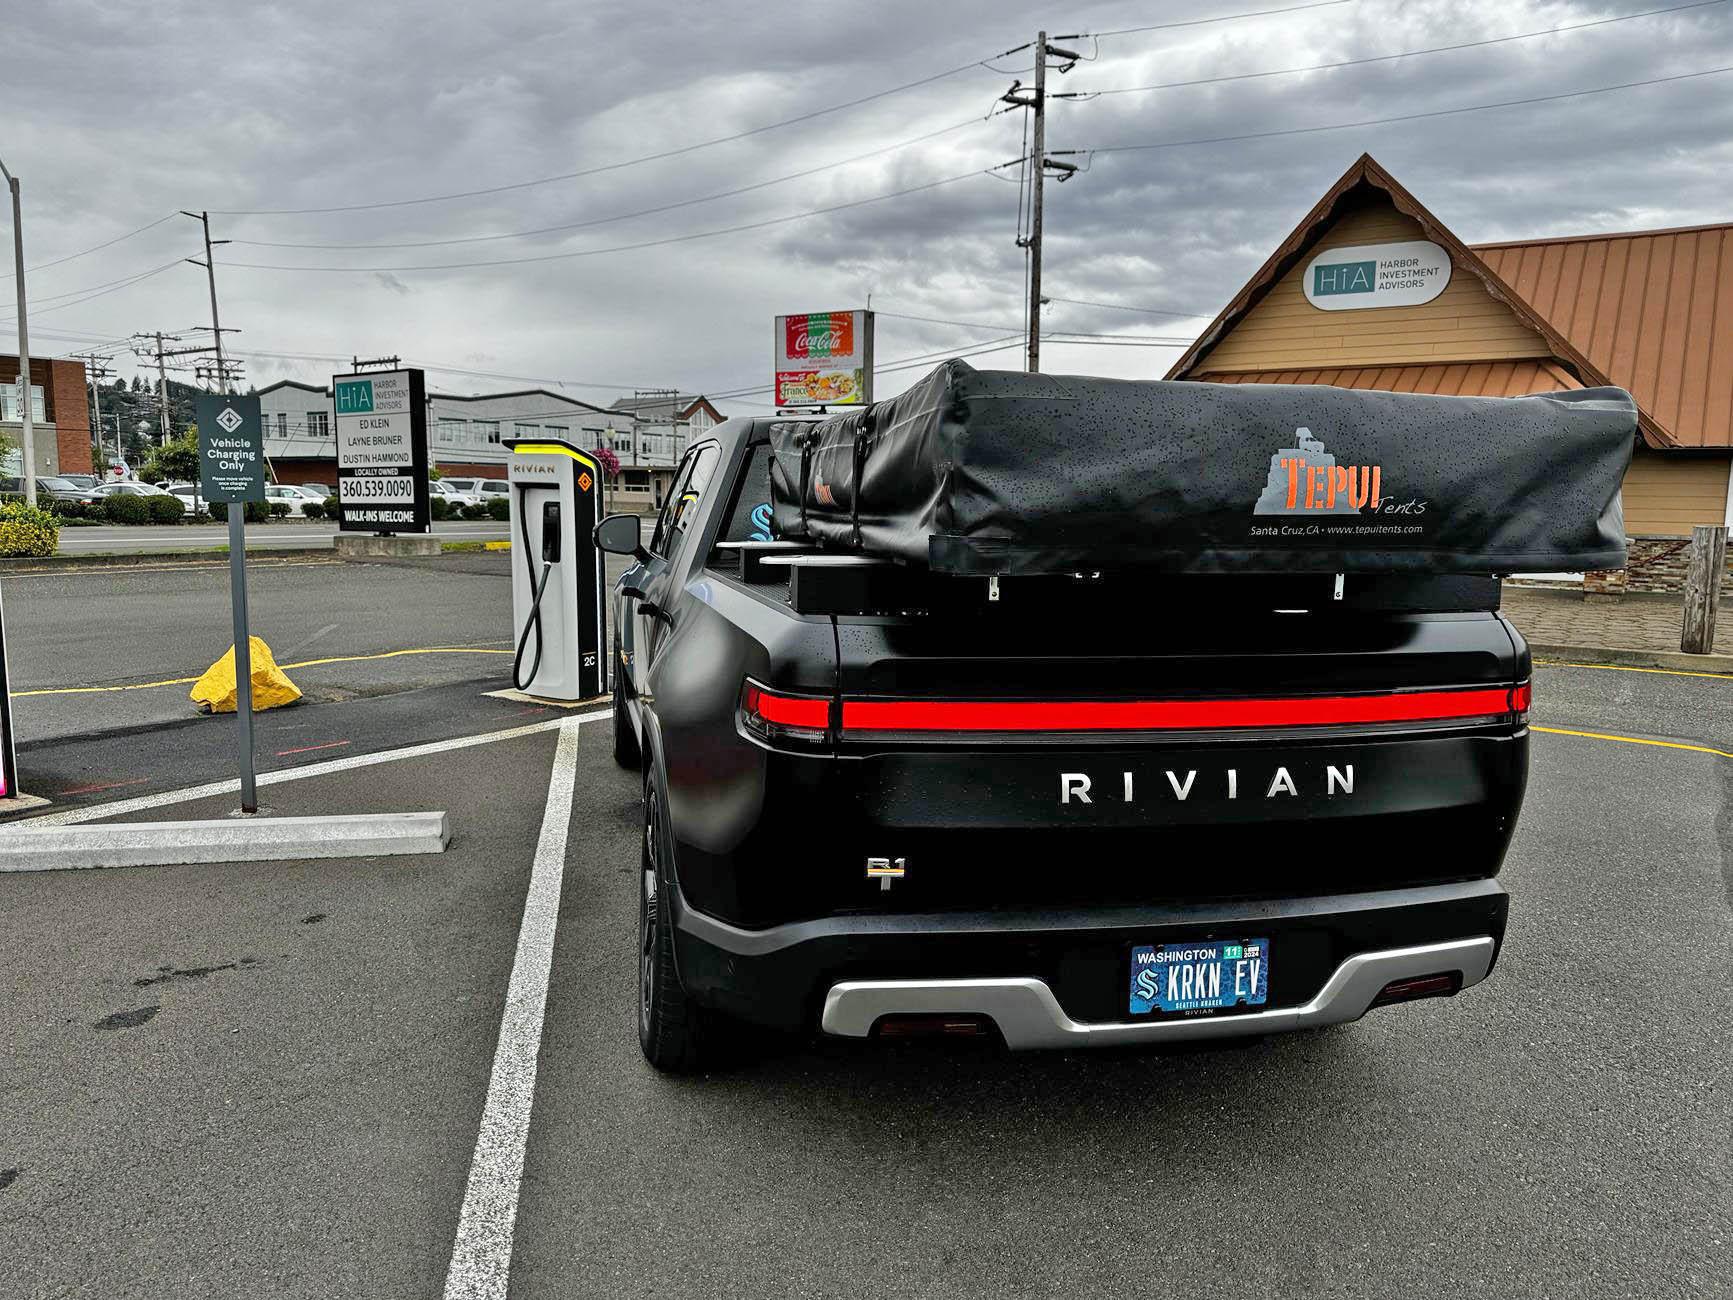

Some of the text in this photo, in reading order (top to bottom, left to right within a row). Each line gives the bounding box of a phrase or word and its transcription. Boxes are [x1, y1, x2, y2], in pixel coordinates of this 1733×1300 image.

[1380, 258, 1419, 269] HARBOR
[1379, 267, 1439, 279] INVESTMENT
[1320, 267, 1369, 291] HiA
[1378, 279, 1424, 290] ADVISORS
[374, 380, 397, 388] HARBOR
[340, 386, 370, 408] HiA
[375, 390, 408, 399] INVESTMENT
[376, 401, 402, 409] ADVISORS
[360, 418, 390, 429] ED KLEIN
[210, 438, 250, 447] Vehicle
[348, 435, 402, 446] LAYNE BRUNER
[207, 450, 255, 461] Charging
[343, 453, 409, 463] DUSTIN HAMMOND
[219, 460, 244, 471] Only
[513, 464, 555, 473] RIVIAN
[354, 467, 398, 476] LOCALLY OWNED
[342, 480, 412, 497] 360.539.0090
[1280, 458, 1381, 509] TEPUI
[1373, 496, 1428, 514] Tents
[344, 510, 414, 522] WALK-INS WELCOME
[1250, 526, 1278, 535] Santa
[1327, 525, 1423, 535] www.tepuitents.com
[584, 656, 596, 666] 2C
[1061, 764, 1353, 803] RIVIAN
[1138, 947, 1237, 964] WASHINGTON 11
[1168, 960, 1260, 1001] KRKN EV
